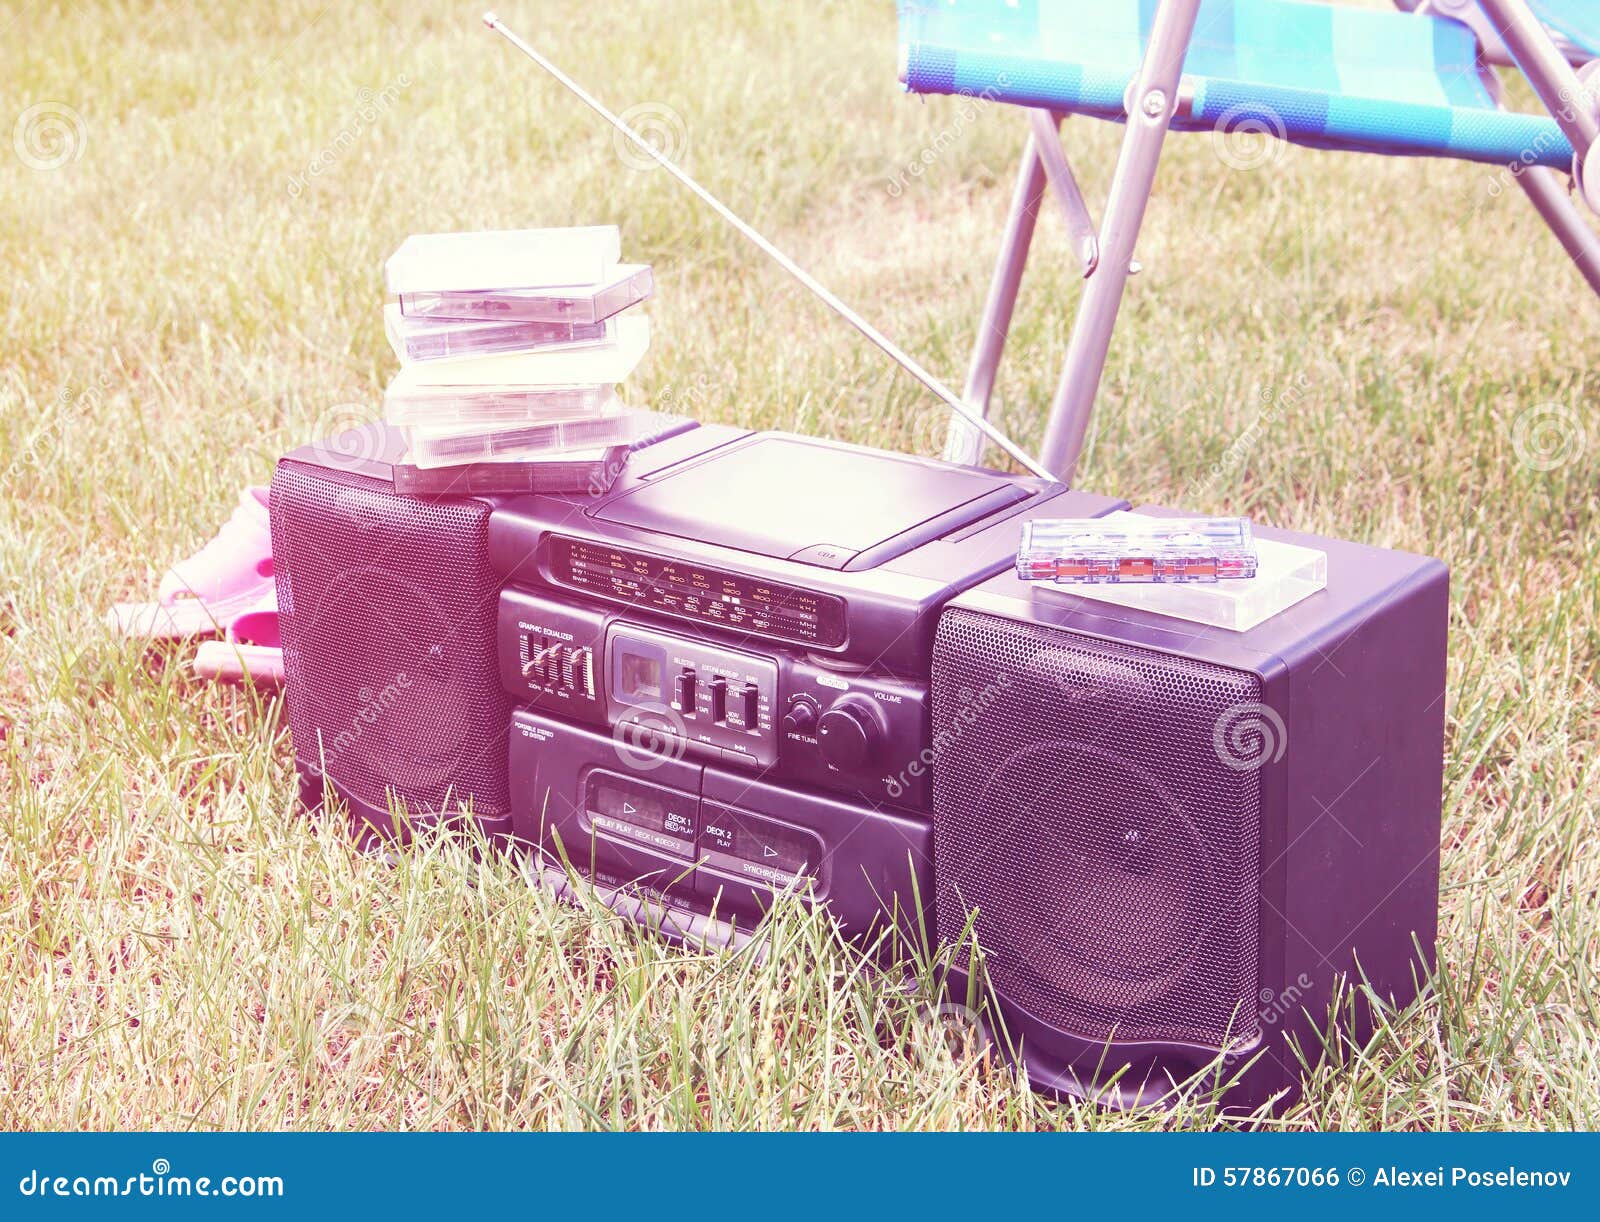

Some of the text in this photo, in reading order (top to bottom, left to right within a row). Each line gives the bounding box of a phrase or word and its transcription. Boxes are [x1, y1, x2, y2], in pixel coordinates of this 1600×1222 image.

[518, 621, 574, 641] GRAPHIC EQUALIZER
[874, 690, 902, 704] VOLUME
[668, 812, 687, 825] DECK
[616, 823, 632, 834] PLAY
[635, 830, 650, 840] DECK
[659, 838, 676, 848] DECK
[706, 825, 732, 840] DECK 2
[717, 838, 731, 848] PLAY
[743, 863, 774, 879] SYNCHRO
